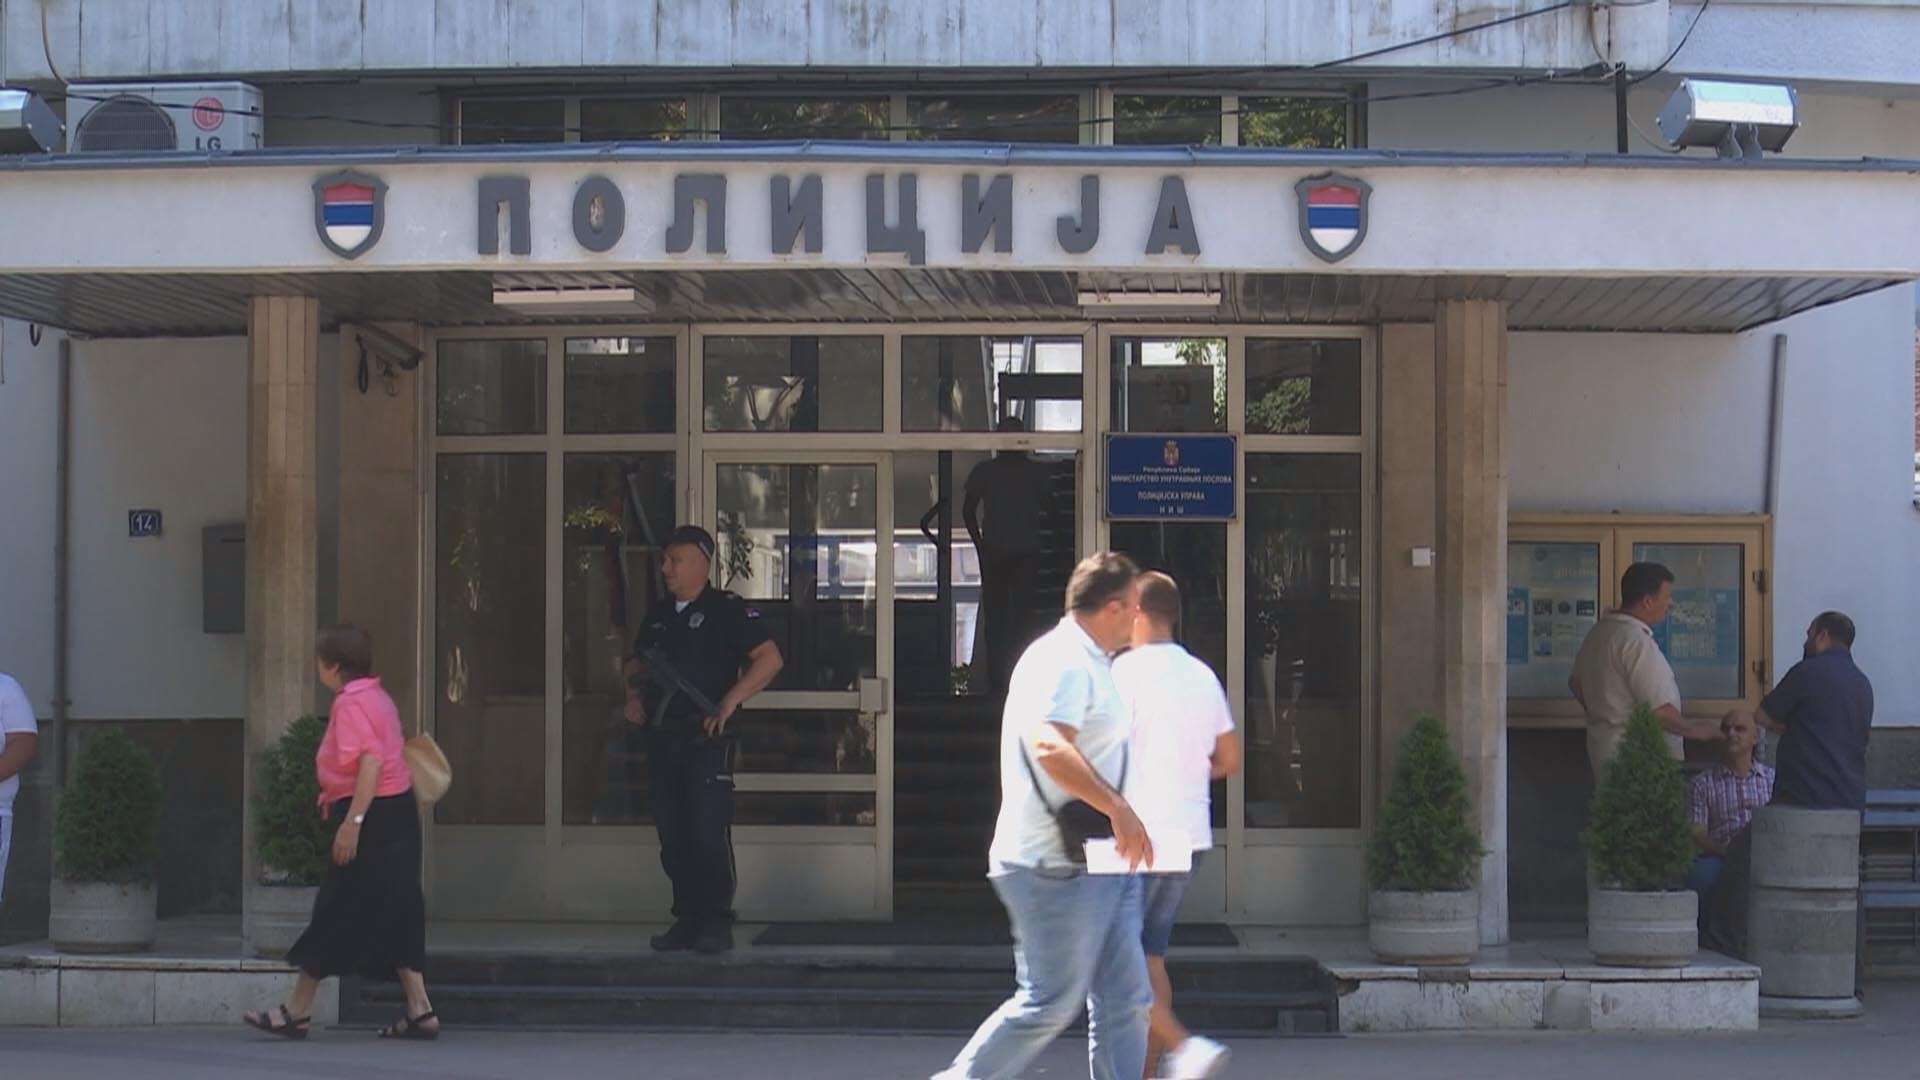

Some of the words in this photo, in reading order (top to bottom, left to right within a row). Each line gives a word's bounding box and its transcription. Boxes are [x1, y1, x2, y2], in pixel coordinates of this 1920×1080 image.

[195, 136, 222, 151] LG
[477, 173, 1201, 265] ПОЛИЦИЈА
[1111, 475, 1159, 483] МИНИСТАРСТВО
[1203, 475, 1232, 483] ПОСЛОВА
[1137, 491, 1179, 501] ПОЛИЦИЈСКА
[1180, 491, 1205, 500] УПРАВА
[136, 514, 152, 531] 14
